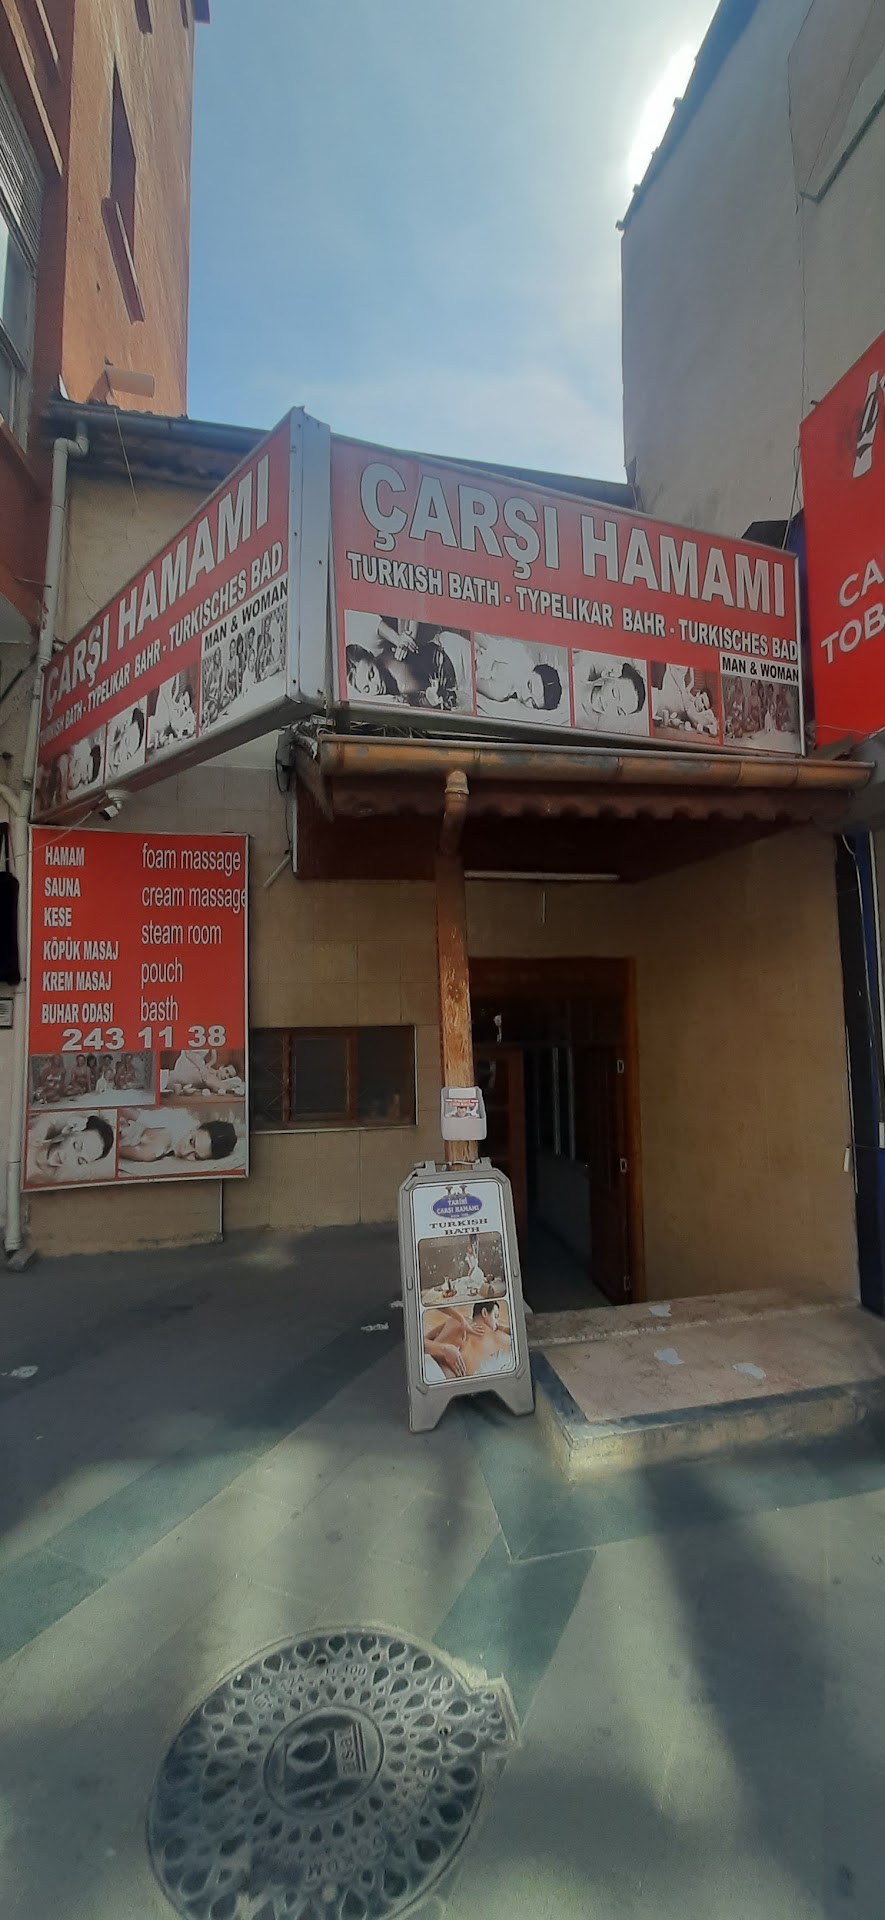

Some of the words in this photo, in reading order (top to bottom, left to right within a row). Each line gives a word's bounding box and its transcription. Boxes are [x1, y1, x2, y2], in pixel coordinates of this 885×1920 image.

[360, 462, 560, 580] ÇARŞI
[580, 514, 785, 618] HAMAMI
[45, 613, 110, 720] ÇARŞI
[117, 454, 269, 651] HAMAMI
[204, 622, 227, 652] MAN
[230, 615, 238, 633] &
[241, 578, 288, 625] WOMAN
[346, 551, 443, 596] TURKISH
[449, 572, 500, 607] BATH
[515, 586, 613, 628] TYPELIKAR
[621, 607, 666, 638] BAHR
[678, 618, 768, 657] TURKISCHES
[772, 637, 798, 661] BAD
[65, 699, 83, 730] BATH
[88, 662, 130, 712] TYPELIKAR
[134, 638, 161, 678] BAHR
[169, 568, 247, 652] TURKISCHES
[251, 541, 283, 592] BAD
[722, 656, 746, 674] MAN
[750, 661, 757, 675] &
[760, 663, 799, 682] WOMAN
[45, 846, 85, 868] HAMAM
[142, 842, 177, 869] foam
[181, 847, 241, 877] massage
[44, 877, 81, 898] SAUNA
[141, 884, 185, 907] cream
[43, 907, 72, 928] KESE
[141, 920, 183, 945] steam
[187, 923, 222, 945] room
[43, 935, 81, 961] KÖPÜK
[83, 941, 119, 962] MASAJ
[42, 971, 73, 992] KREM
[76, 971, 112, 992] MASAJ
[141, 957, 183, 989] pouch
[41, 1003, 79, 1024] BUHAR
[81, 1002, 113, 1024] ODASI
[140, 996, 178, 1022] basth
[61, 1028, 125, 1052] 243
[137, 1026, 173, 1049] 11
[188, 1025, 226, 1048] 38
[429, 1218, 488, 1229] TURKISH
[444, 1226, 480, 1236] BATH
